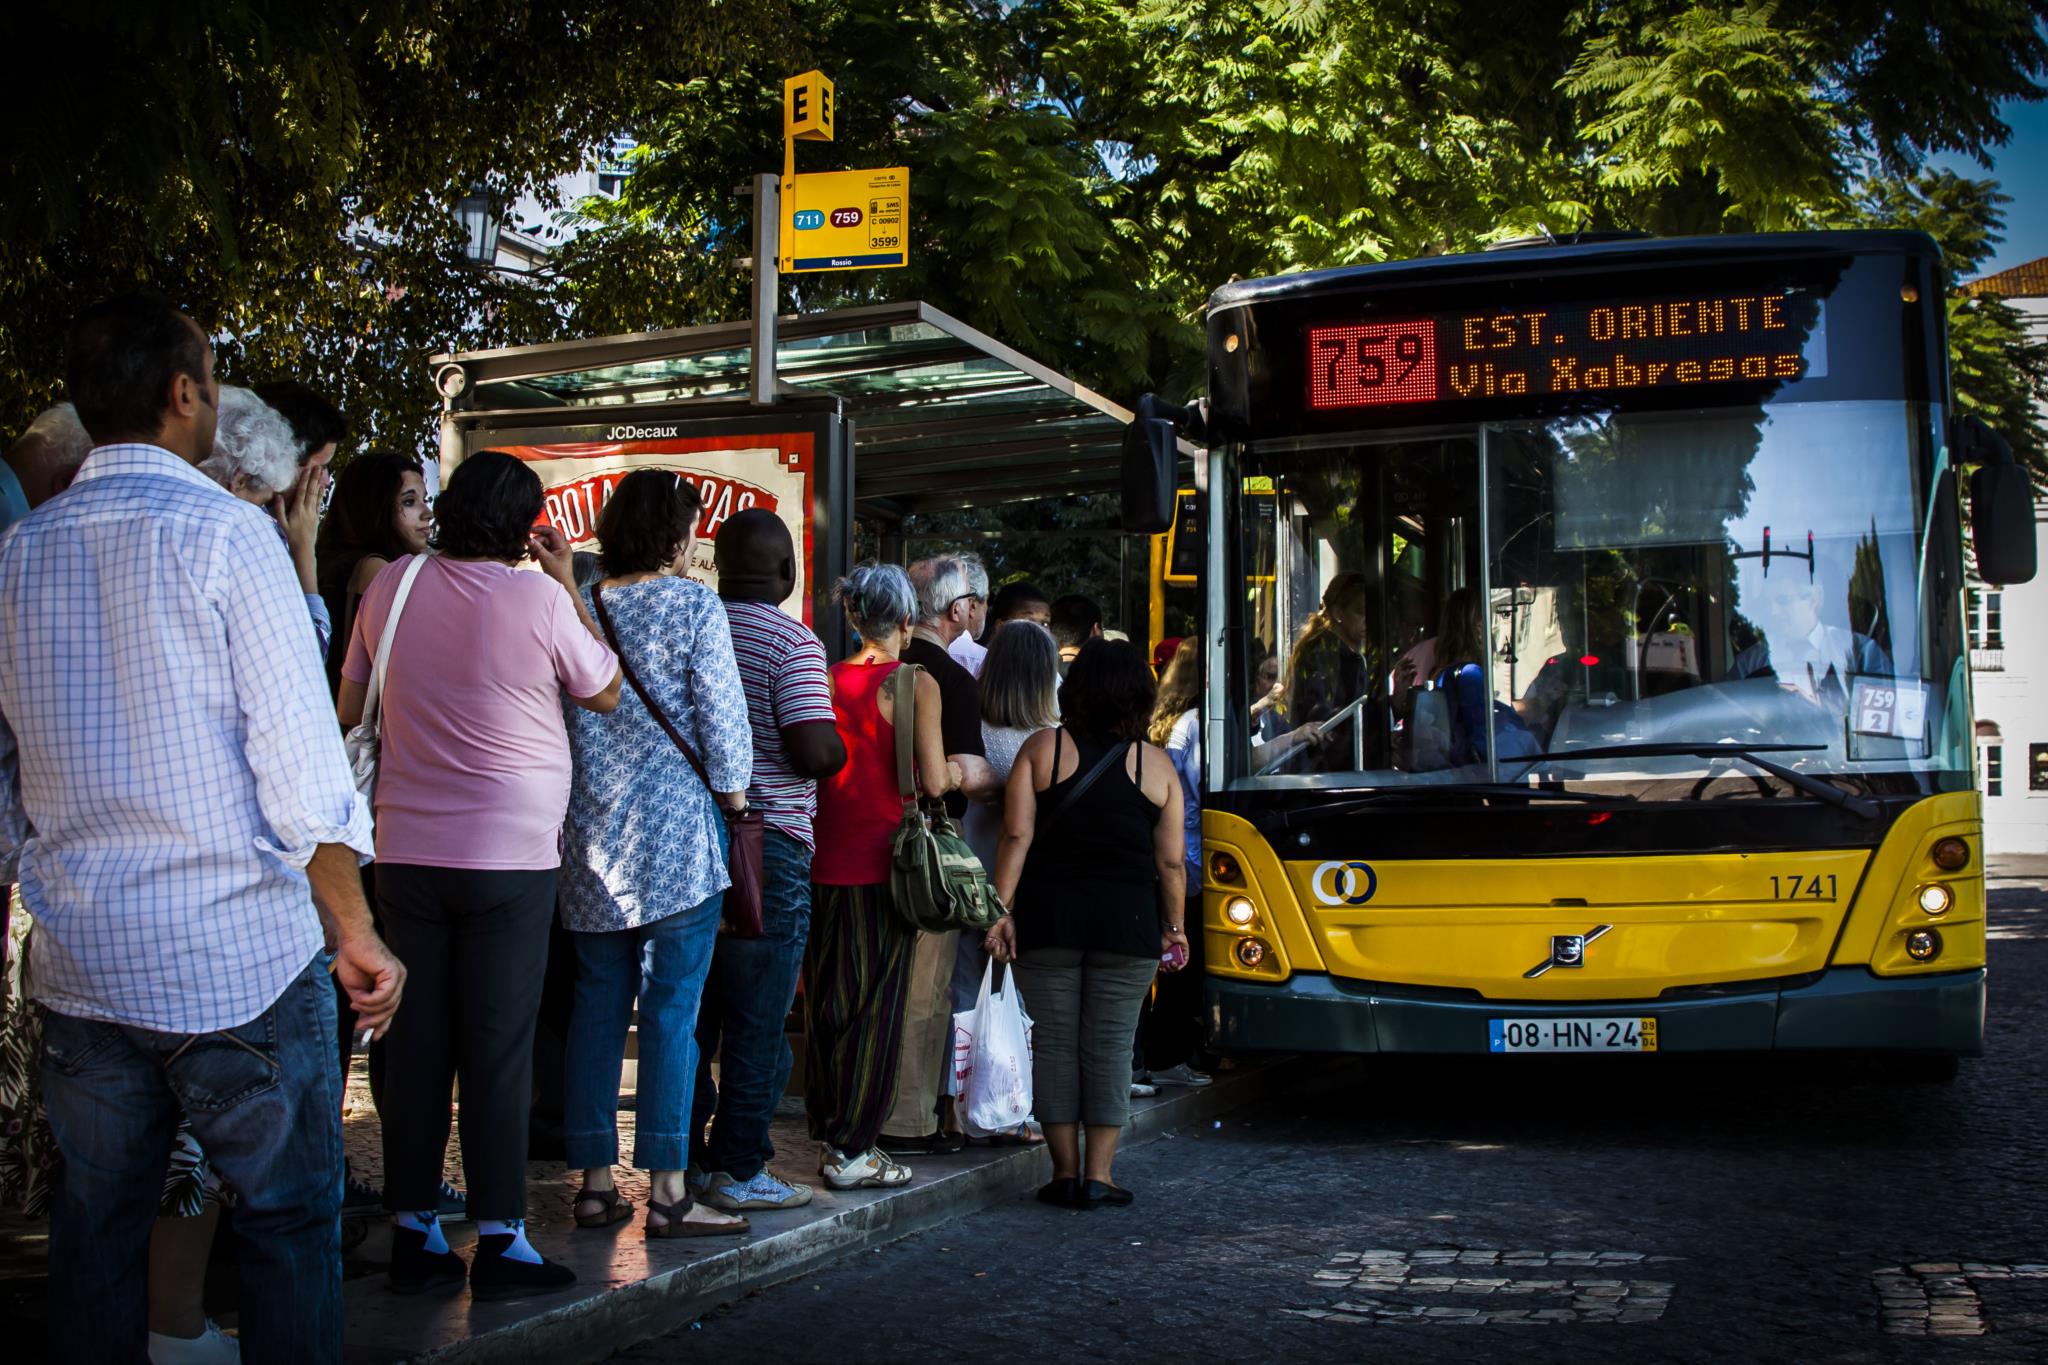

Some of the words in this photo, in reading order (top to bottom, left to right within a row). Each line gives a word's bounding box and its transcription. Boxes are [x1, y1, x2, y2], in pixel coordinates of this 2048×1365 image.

[793, 85, 808, 124] E
[821, 86, 830, 126] E
[796, 214, 820, 226] 711
[834, 212, 859, 224] 759
[878, 217, 899, 225] 00902
[871, 236, 898, 247] 3599
[831, 258, 852, 266] Rossio
[1464, 312, 1564, 350] EST.
[1590, 296, 1786, 341] ORIENTE
[1317, 331, 1425, 392] 759
[1449, 362, 1527, 397] Via
[1551, 354, 1801, 391] Xabregas
[606, 425, 678, 440] JCDecaux
[1863, 688, 1895, 708] 759
[1870, 713, 1882, 730] 2
[1770, 874, 1837, 898] 1741
[1642, 1021, 1655, 1030] 09
[1642, 1038, 1655, 1047] 04
